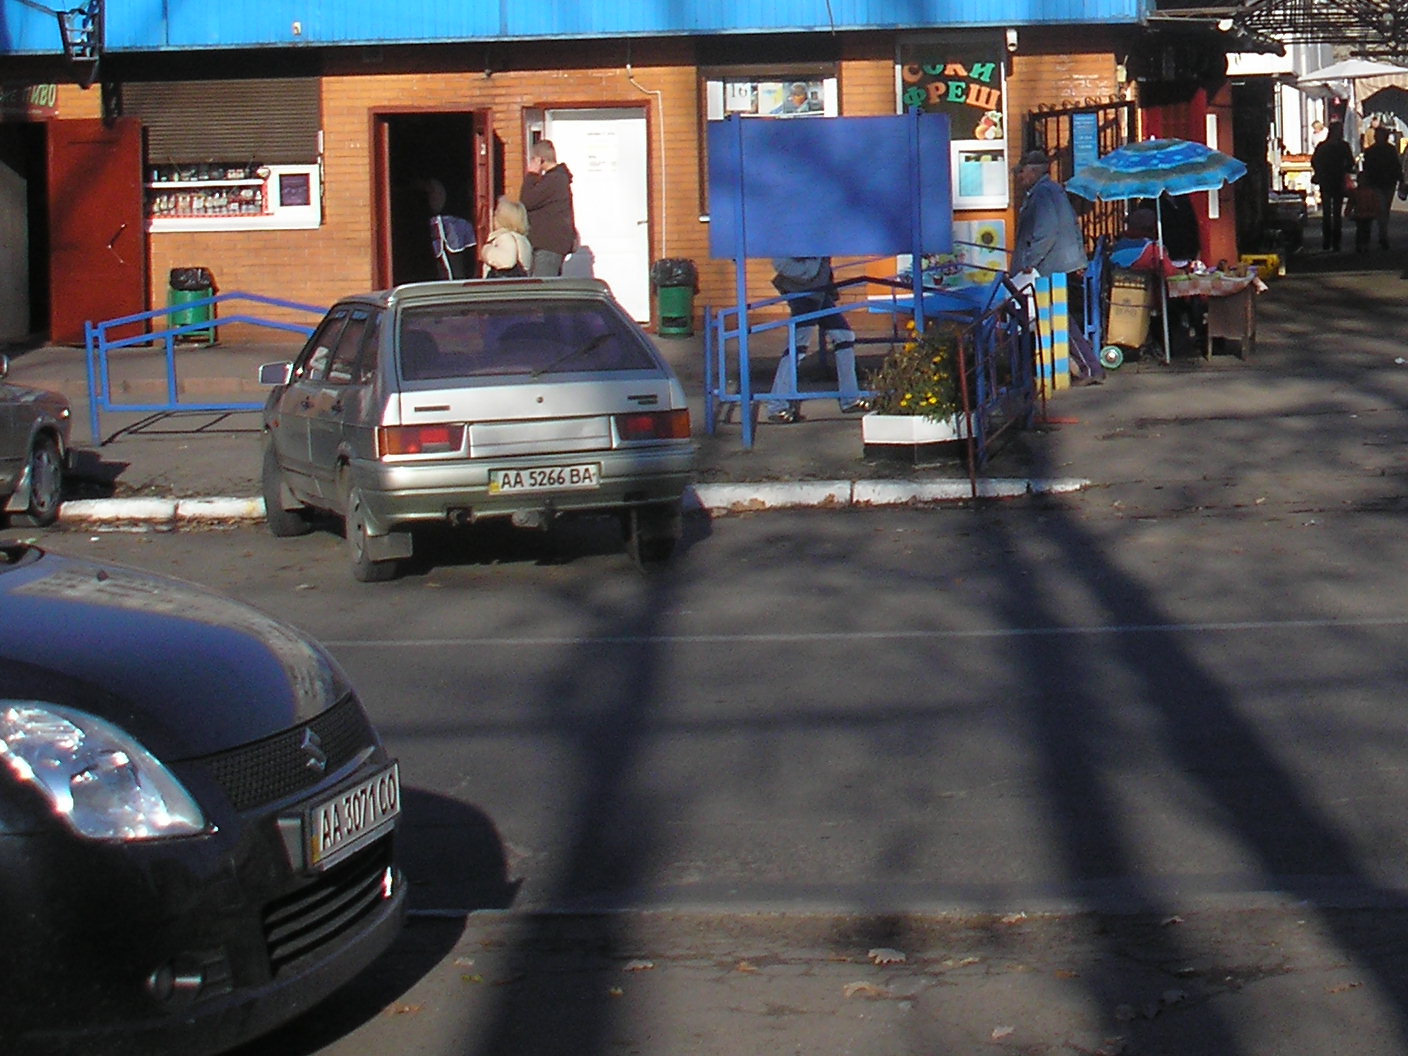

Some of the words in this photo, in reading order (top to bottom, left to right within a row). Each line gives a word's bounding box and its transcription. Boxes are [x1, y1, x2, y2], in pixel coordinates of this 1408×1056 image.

[903, 81, 1001, 110] ФРЕШ
[501, 469, 525, 489] AA
[529, 468, 566, 487] 5266
[570, 467, 593, 484] BA
[321, 803, 342, 851] AA
[343, 782, 377, 835] 3071
[377, 773, 397, 816] CO
